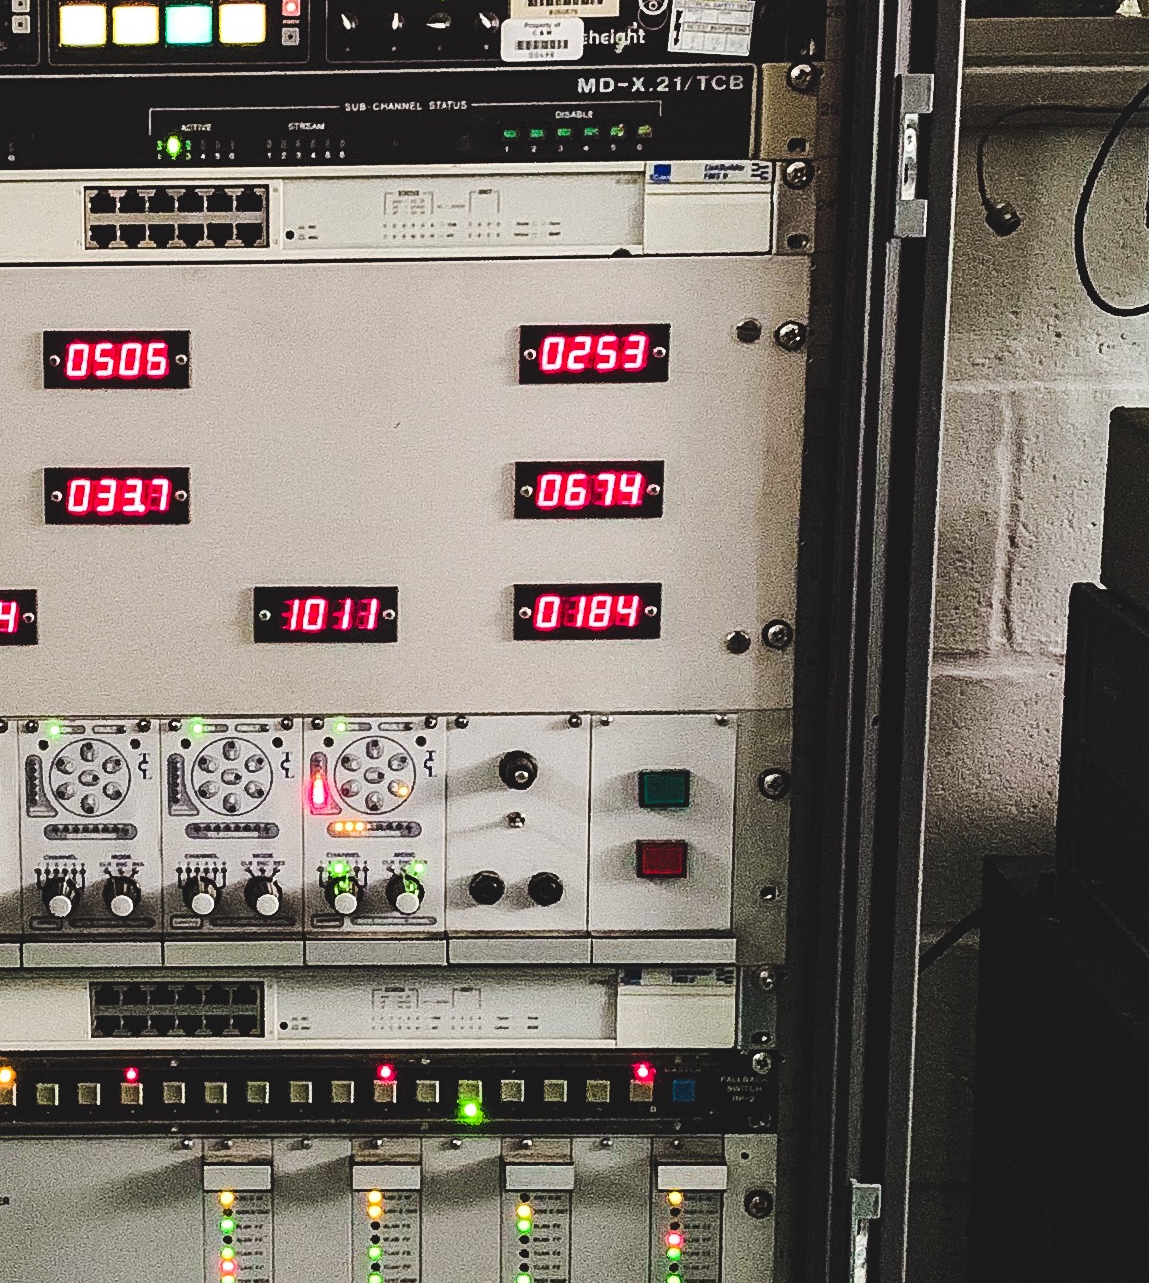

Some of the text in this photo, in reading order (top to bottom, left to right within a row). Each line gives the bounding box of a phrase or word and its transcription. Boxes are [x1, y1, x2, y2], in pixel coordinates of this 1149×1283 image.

[577, 74, 745, 95] MD-X.21/TCB
[428, 99, 468, 111] STATUS
[65, 342, 169, 377] 0506
[540, 336, 647, 372] 0253
[537, 473, 642, 508] 0674
[289, 597, 377, 630] 1011
[536, 595, 639, 629] 0184
